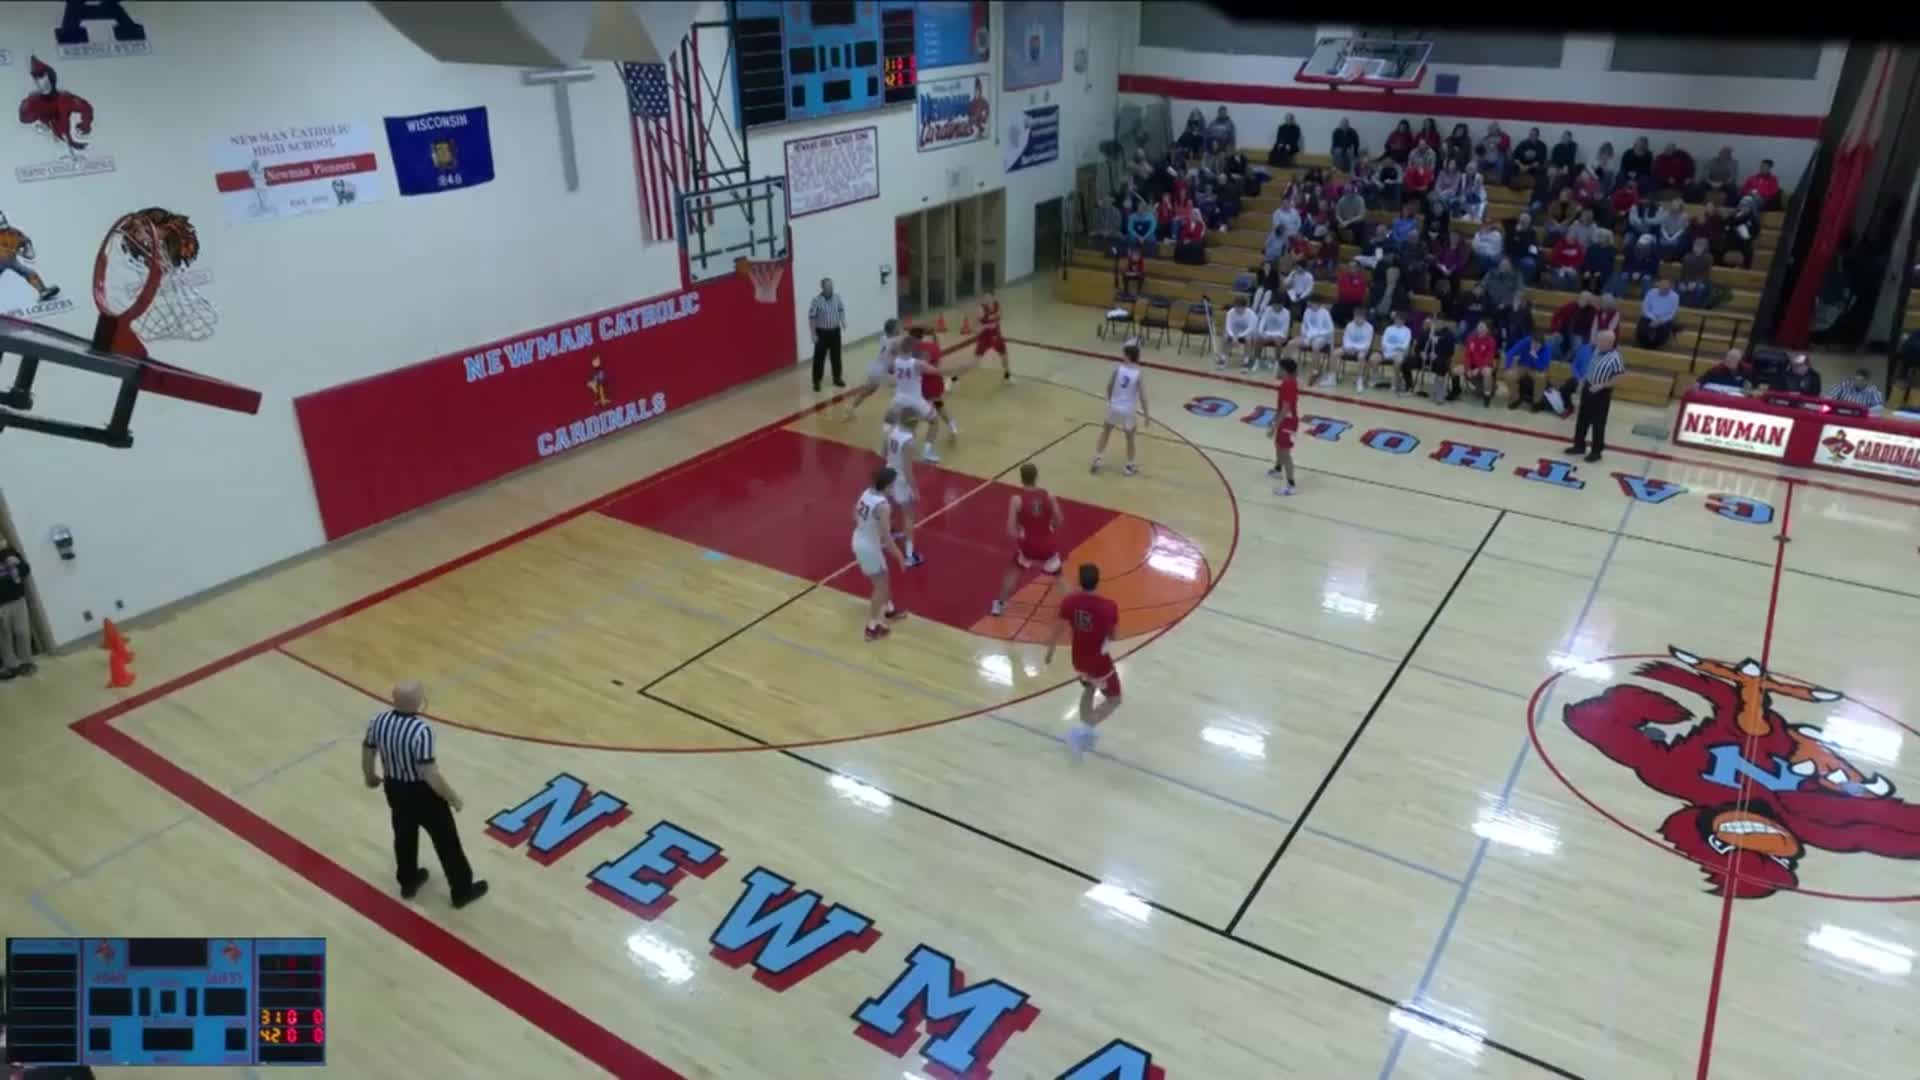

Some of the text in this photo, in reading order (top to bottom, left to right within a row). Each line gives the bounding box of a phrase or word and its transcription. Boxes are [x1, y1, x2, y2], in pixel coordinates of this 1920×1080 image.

[406, 113, 468, 132] WISCONSIN
[230, 123, 350, 146] NEWMAN CATHOLIC
[252, 137, 336, 157] HIGH SCHOOL
[267, 167, 311, 181] Newman
[463, 292, 700, 382] NEWMAN CATHOLIC
[536, 392, 666, 457] CARDINALS
[1684, 412, 1786, 447] NEWMAN
